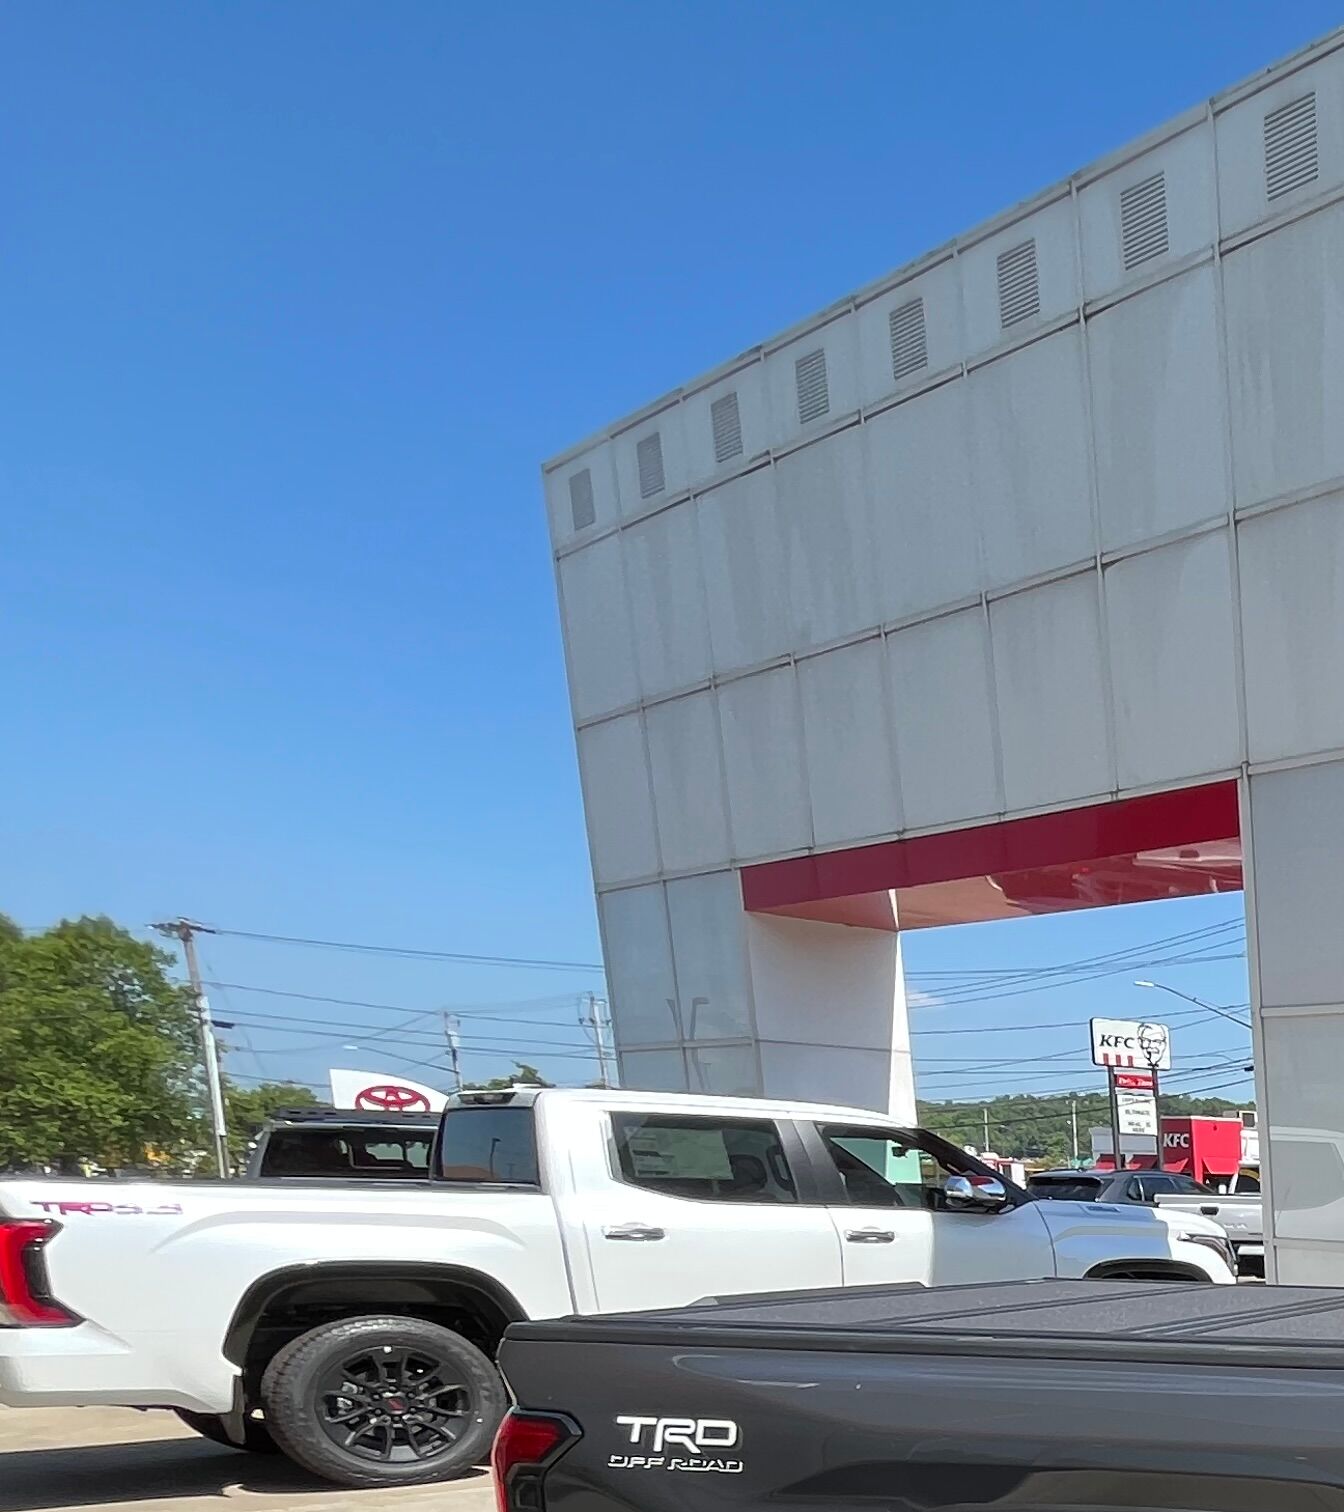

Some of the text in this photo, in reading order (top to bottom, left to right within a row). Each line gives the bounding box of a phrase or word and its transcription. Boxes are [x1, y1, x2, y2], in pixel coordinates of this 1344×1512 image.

[1099, 1033, 1135, 1050] KFC
[1162, 1132, 1190, 1148] KFC
[616, 1415, 738, 1454] TRD
[607, 1454, 744, 1474] OFF ROAD
